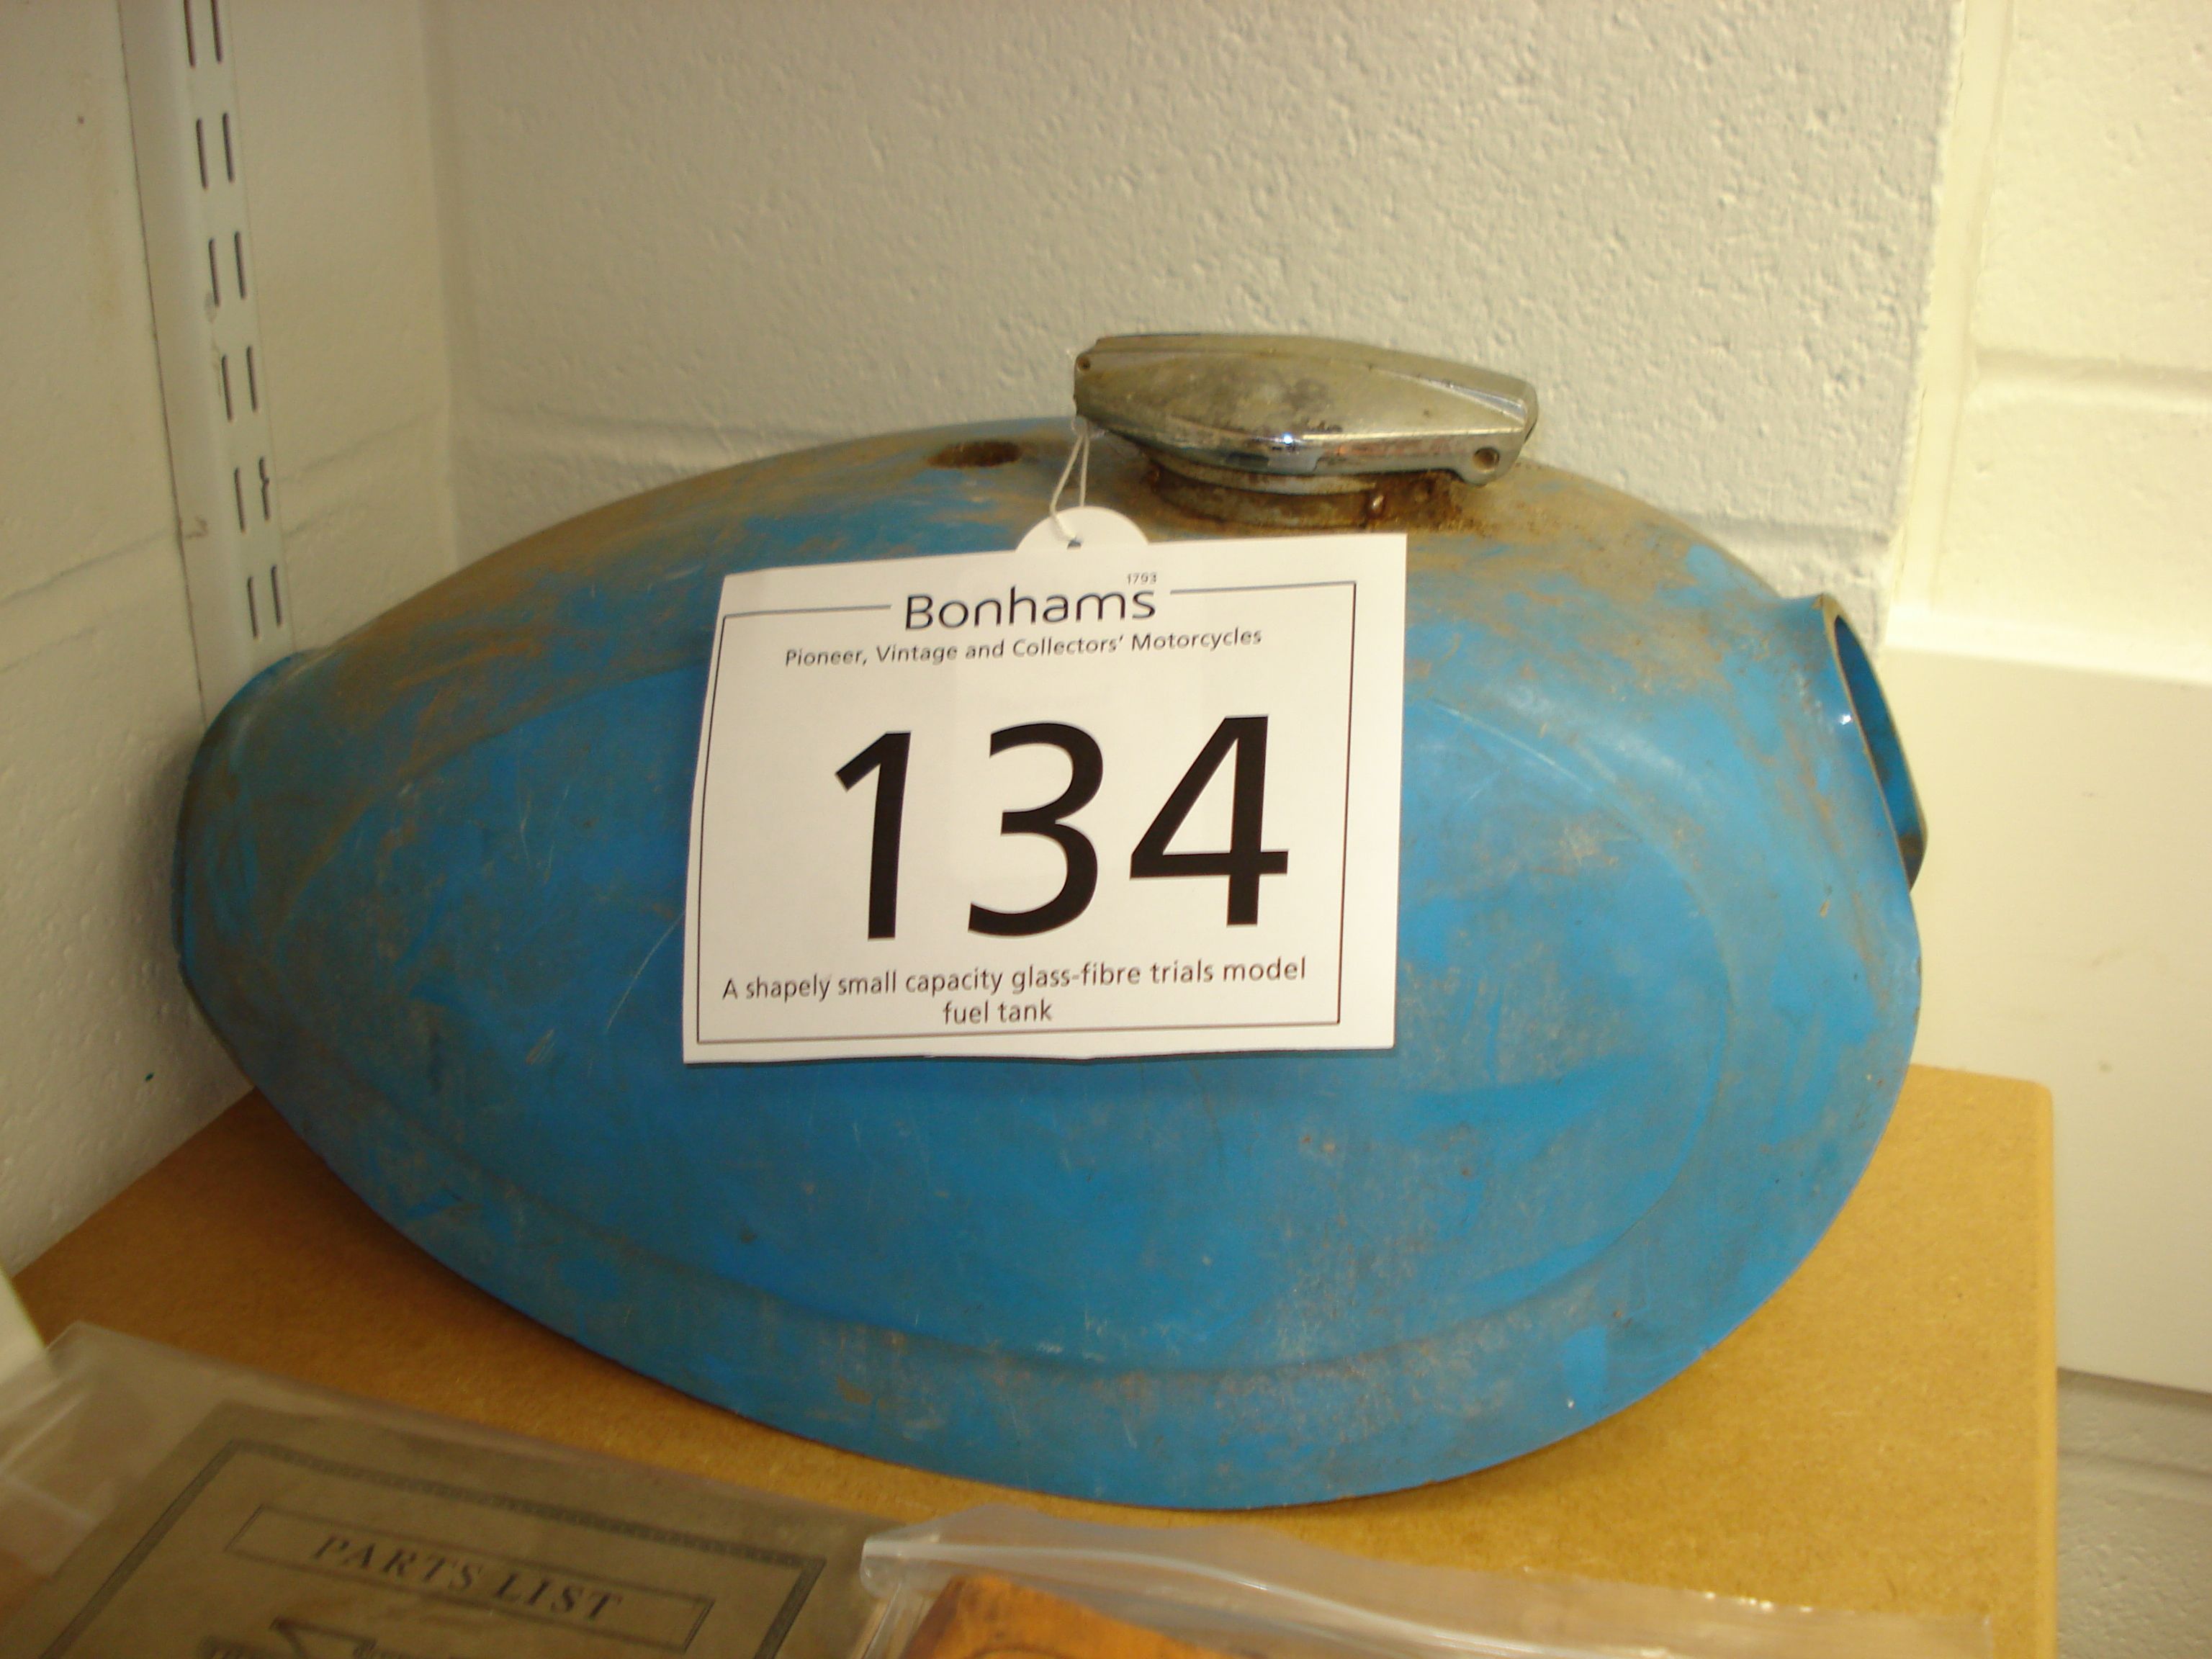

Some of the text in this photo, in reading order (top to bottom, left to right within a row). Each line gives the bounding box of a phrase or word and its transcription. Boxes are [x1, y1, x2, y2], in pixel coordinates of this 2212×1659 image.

[905, 585, 1156, 631] Bonhams
[786, 649, 867, 667] Pioneer,
[876, 644, 958, 664] Vintage
[965, 643, 1004, 660] and
[1131, 631, 1262, 652] Motorcycles
[835, 714, 1289, 941] 134
[722, 956, 1306, 1002] A shapely small capacity glass-fibre trials model
[943, 997, 1053, 1025] fuel tank
[312, 1535, 624, 1620] PARTS LIST
